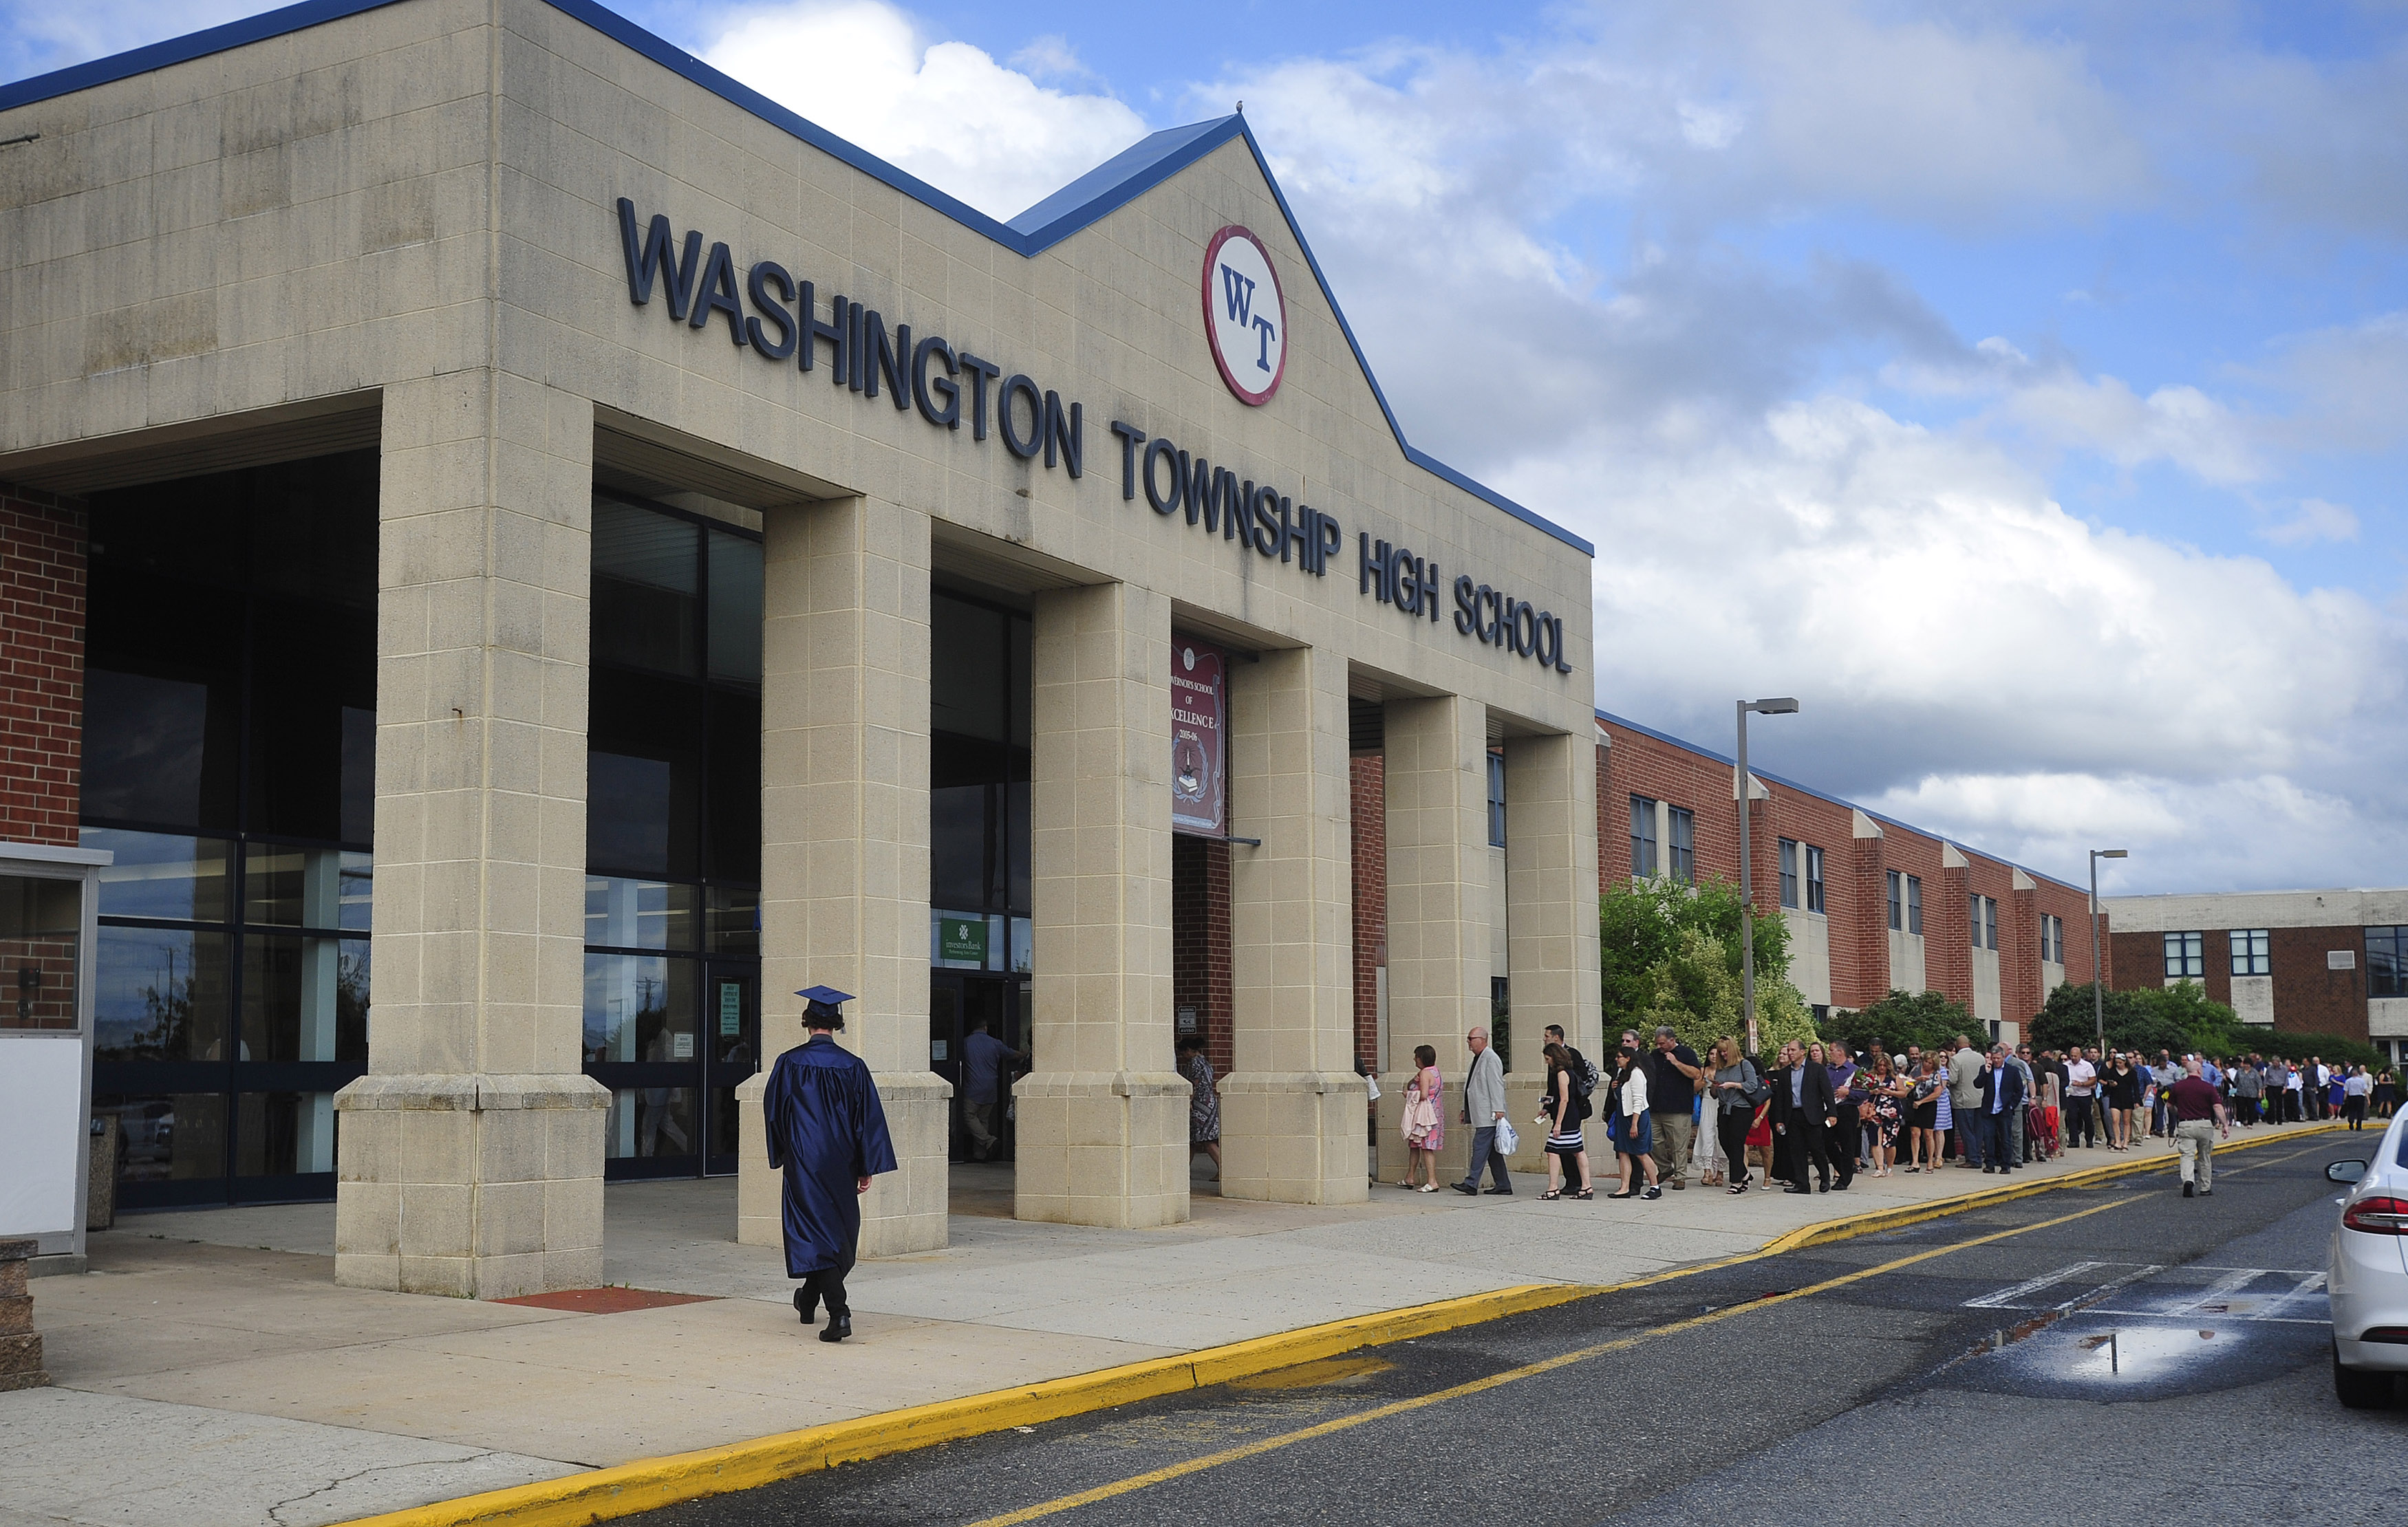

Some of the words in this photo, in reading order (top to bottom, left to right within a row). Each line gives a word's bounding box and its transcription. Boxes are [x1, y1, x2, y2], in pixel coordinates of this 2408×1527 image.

[617, 197, 1082, 479] WASHINGTON
[1111, 420, 1341, 576] TOWNSHIP
[1359, 532, 1439, 622] HIGH
[1454, 574, 1572, 673] SCHOOL
[1194, 682, 1214, 695] SCHOOL
[1185, 695, 1193, 705] OF
[1170, 708, 1214, 729] XCELLENCE
